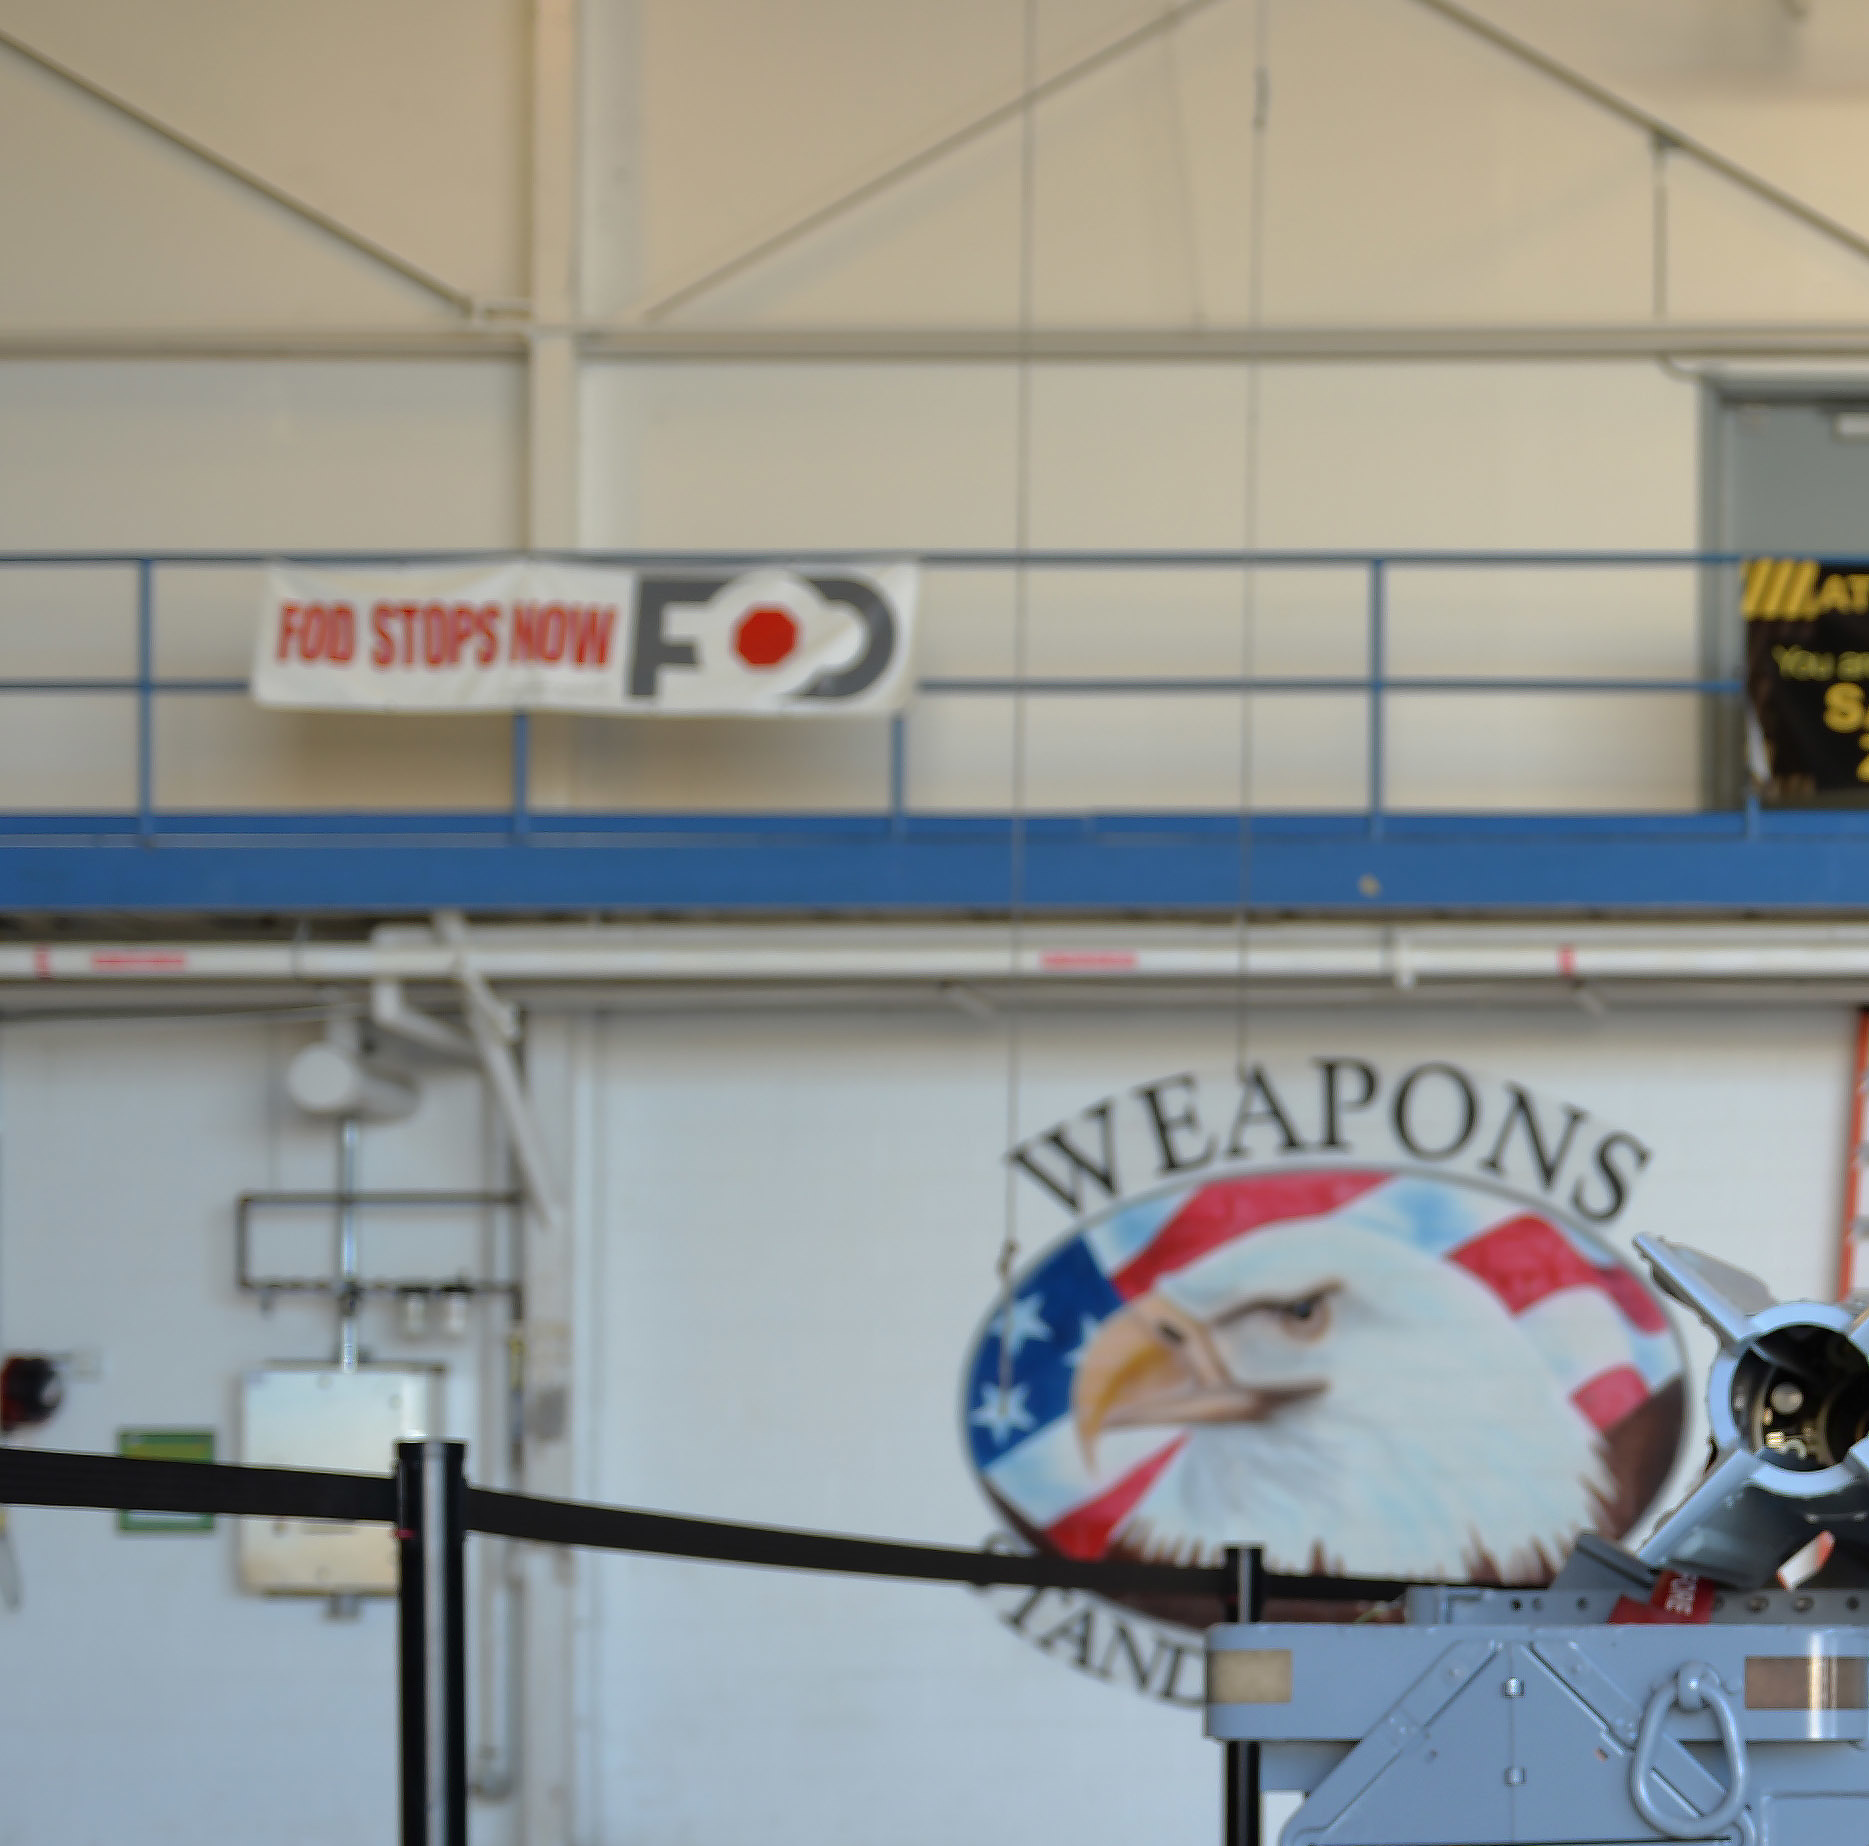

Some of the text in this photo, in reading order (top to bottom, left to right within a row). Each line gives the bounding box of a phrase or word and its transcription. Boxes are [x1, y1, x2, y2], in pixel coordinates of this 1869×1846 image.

[275, 600, 616, 668] FOD STOPS NOW
[1005, 1056, 1654, 1225] WEAPONS
